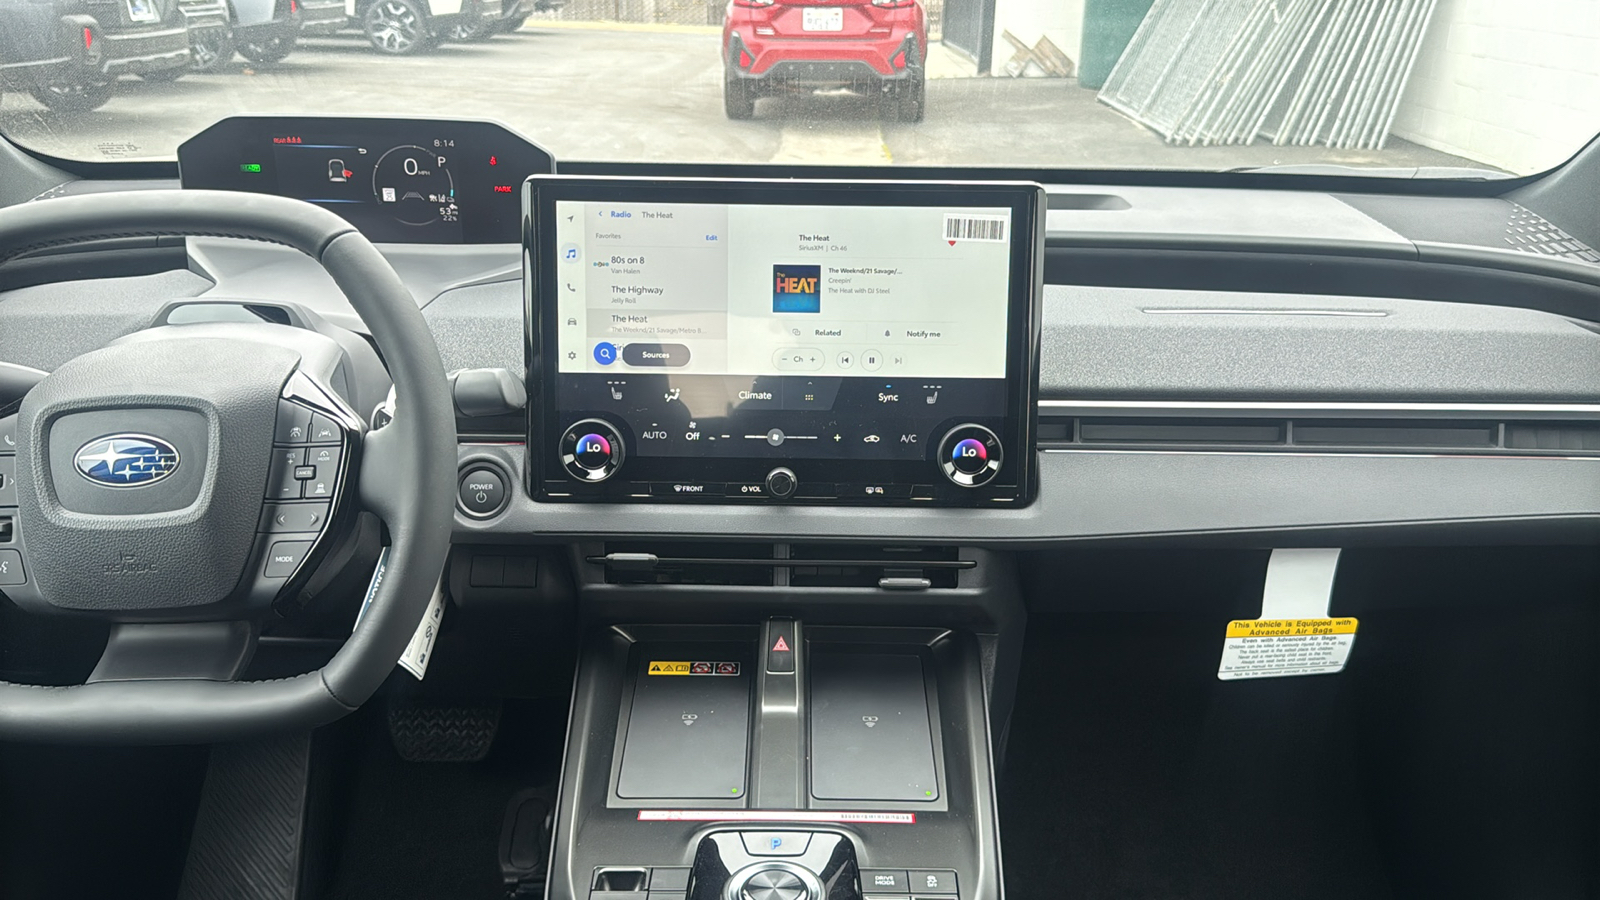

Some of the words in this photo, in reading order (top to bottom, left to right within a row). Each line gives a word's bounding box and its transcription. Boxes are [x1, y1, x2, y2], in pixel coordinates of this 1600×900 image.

[434, 139, 454, 147] 8:14
[438, 156, 446, 168] P
[404, 158, 418, 176] 0
[611, 256, 626, 264] 80s
[776, 278, 817, 293] HEAT
[628, 286, 664, 295] Highway
[906, 330, 928, 338] Notify
[738, 391, 772, 400] Climate
[878, 393, 898, 403] Sync
[642, 431, 667, 439] AUTO
[686, 432, 700, 441] Off
[900, 434, 917, 443] A/C
[586, 442, 601, 452] Lo
[962, 447, 976, 457] Lo
[771, 837, 782, 850] P
